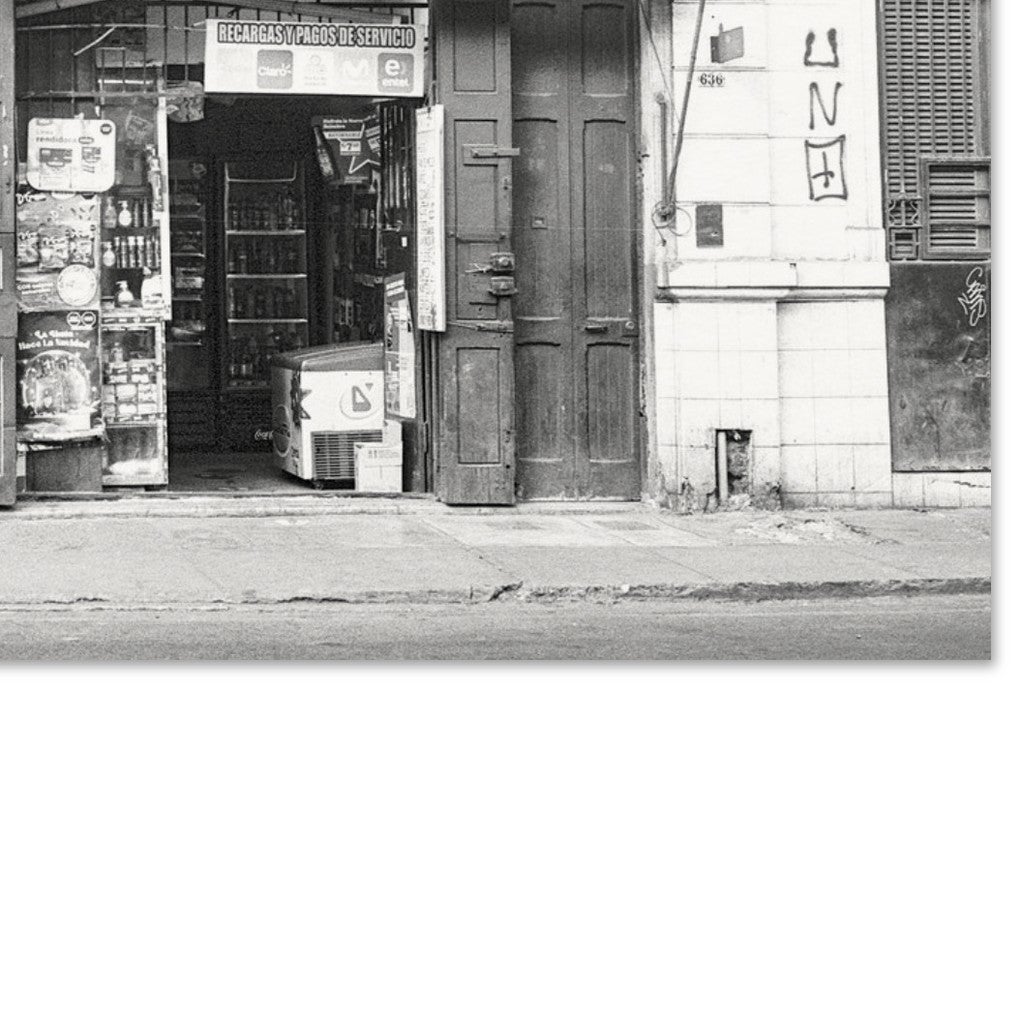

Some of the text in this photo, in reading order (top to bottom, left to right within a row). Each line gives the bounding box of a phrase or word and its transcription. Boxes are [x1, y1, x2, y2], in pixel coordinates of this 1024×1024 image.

[218, 22, 416, 49] RECARGAS Y PAGOS DE SERVICIO
[258, 64, 292, 77] Claro
[382, 78, 409, 87] entel
[699, 72, 724, 86] 636
